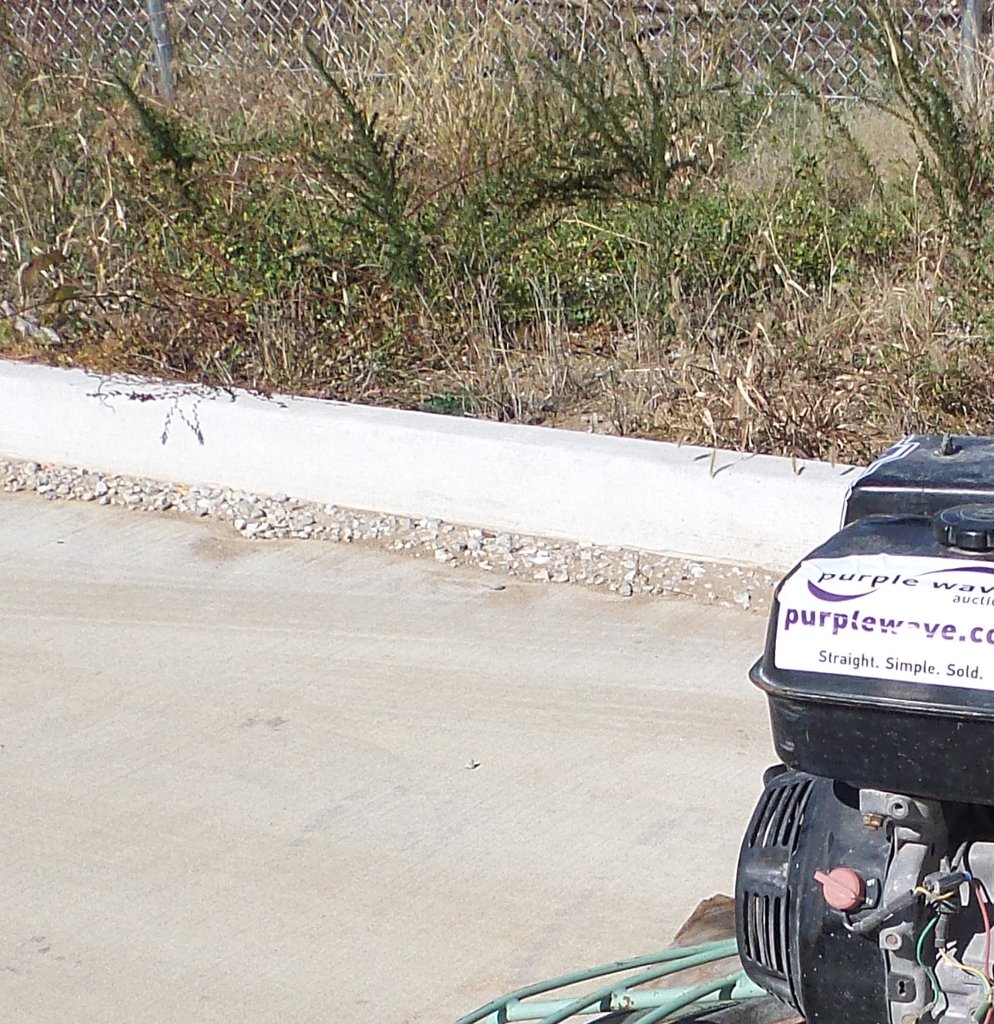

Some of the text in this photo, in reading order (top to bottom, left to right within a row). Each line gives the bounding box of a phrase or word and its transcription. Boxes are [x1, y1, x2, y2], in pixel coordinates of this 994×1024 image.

[817, 571, 919, 588] purple
[818, 650, 984, 680] Straight. Simple. Sold.
